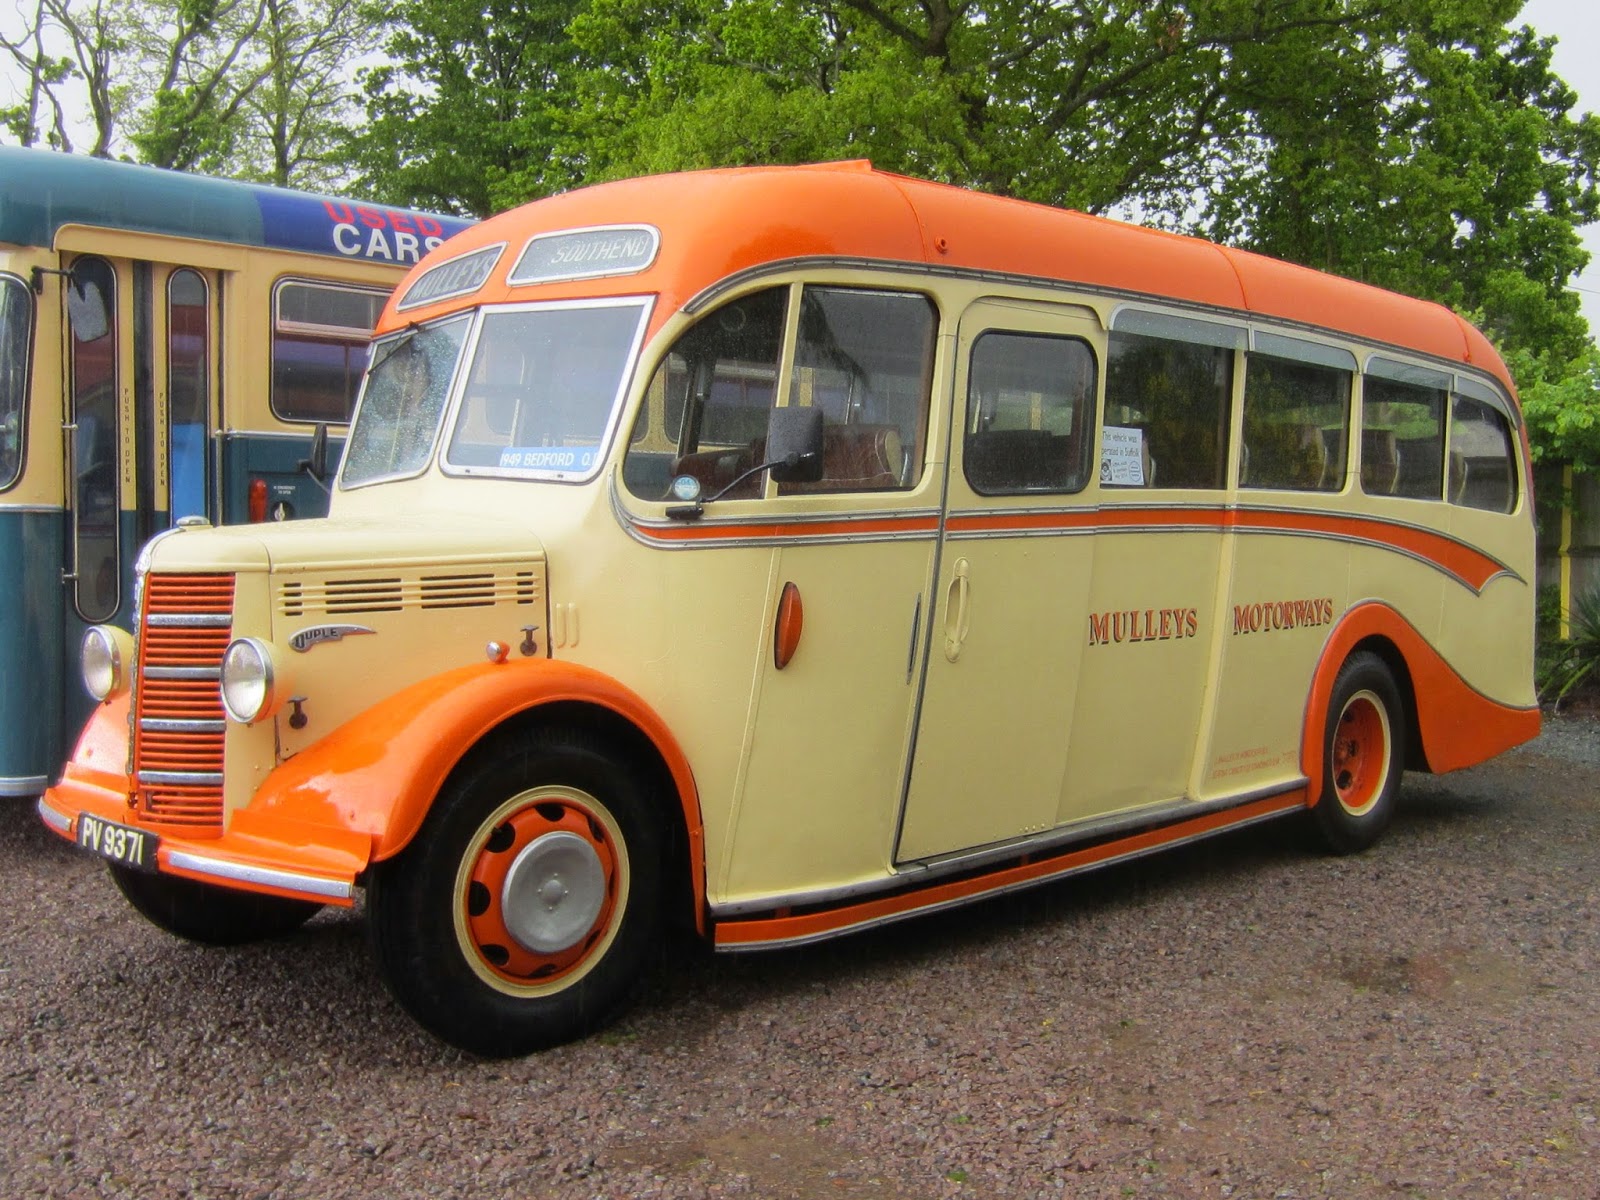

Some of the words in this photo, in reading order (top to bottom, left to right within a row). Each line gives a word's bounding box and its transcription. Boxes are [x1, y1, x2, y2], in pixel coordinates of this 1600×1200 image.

[322, 200, 442, 236] USED
[551, 236, 649, 263] SOUTHEND
[126, 428, 130, 443] TO
[160, 432, 165, 447] TO
[500, 453, 521, 467] 1949
[523, 452, 574, 466] BEDFORD
[1089, 608, 1198, 646] MULLEYS
[1233, 598, 1332, 635] MOTORWAYS
[293, 627, 338, 649] DUPLE
[82, 817, 102, 850] PV
[104, 825, 144, 865] 9371
